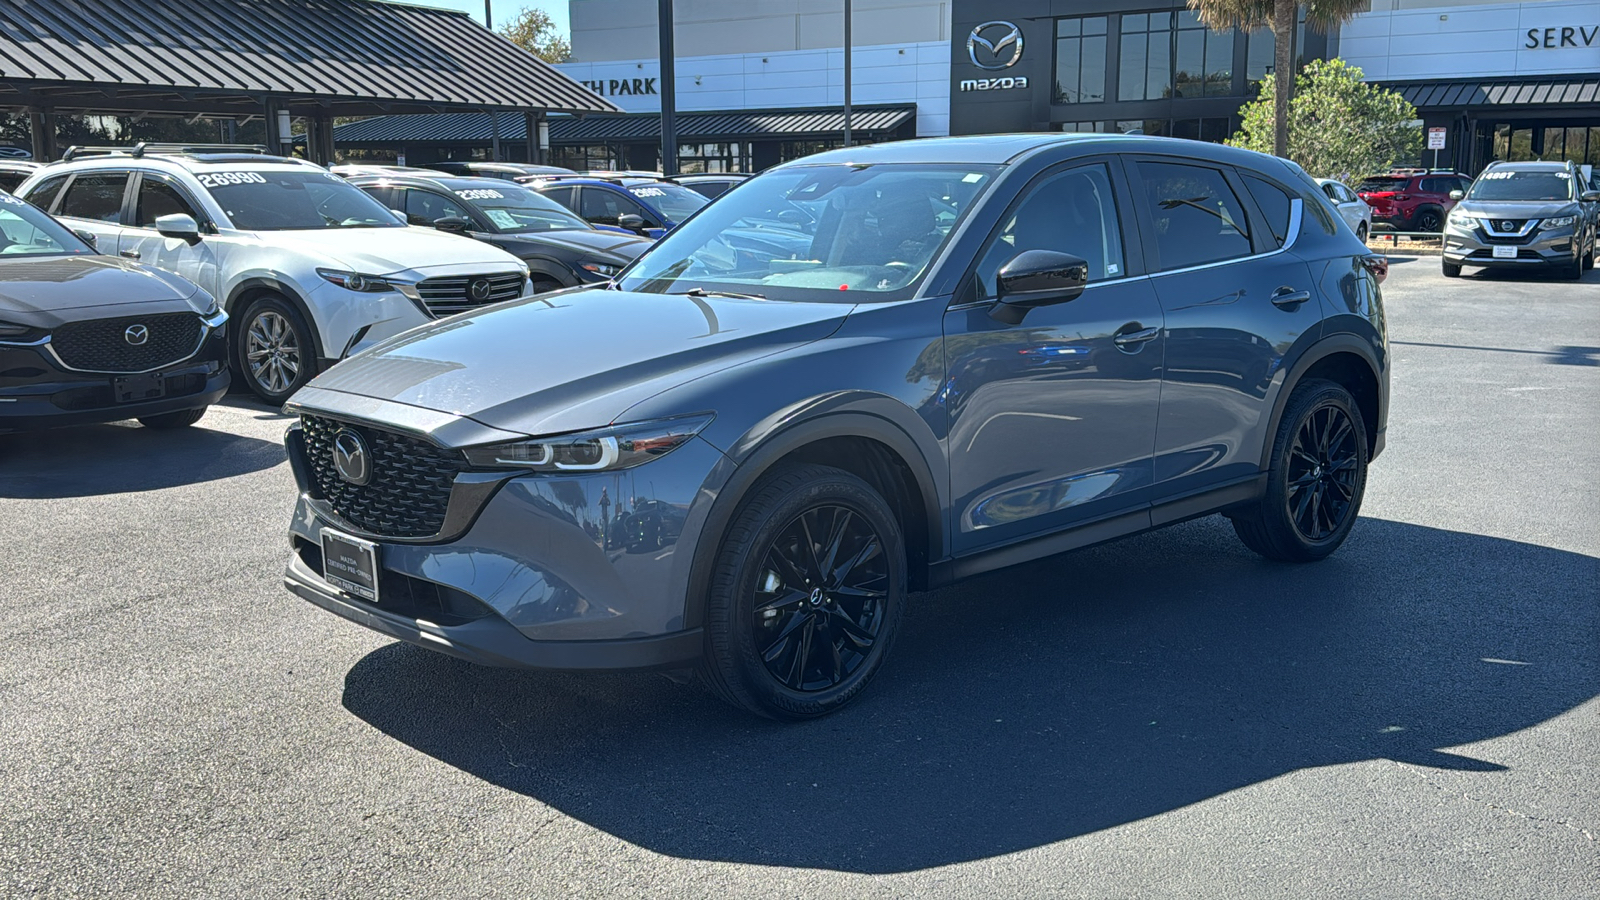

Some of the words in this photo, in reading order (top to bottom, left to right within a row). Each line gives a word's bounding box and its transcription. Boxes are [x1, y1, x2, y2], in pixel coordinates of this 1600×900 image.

[1525, 25, 1600, 49] SERV
[609, 77, 657, 96] PARK
[960, 76, 1027, 92] mazda
[197, 171, 267, 188] 26990
[327, 558, 347, 571] CERTIFIED
[340, 555, 358, 566] MAZDA
